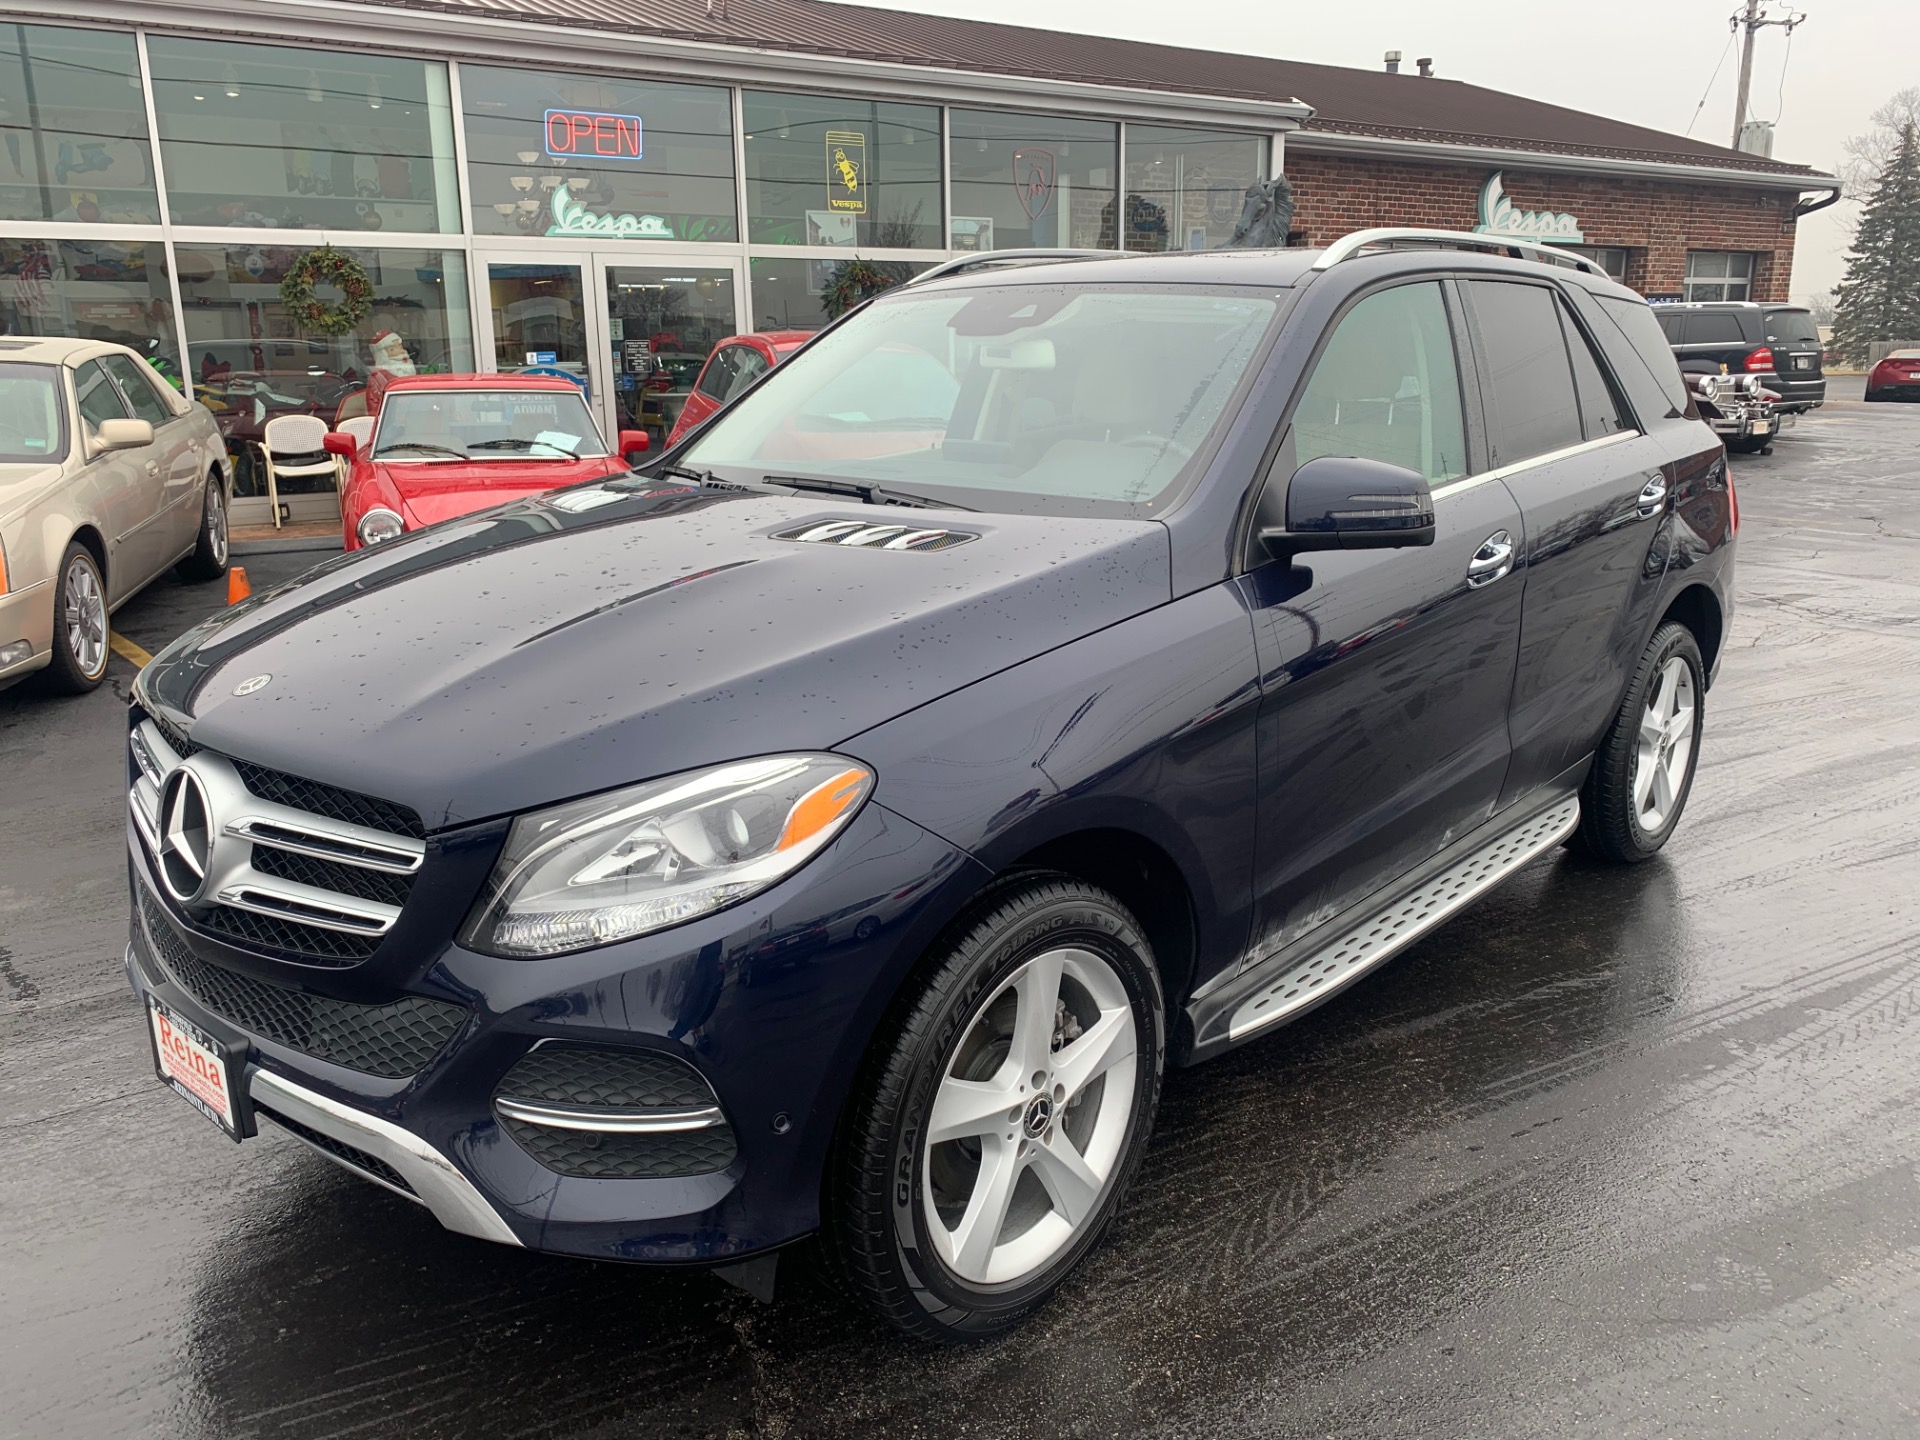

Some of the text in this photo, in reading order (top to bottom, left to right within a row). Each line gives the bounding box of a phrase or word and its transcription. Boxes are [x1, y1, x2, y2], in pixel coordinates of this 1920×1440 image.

[548, 113, 639, 156] OPEN
[545, 183, 675, 239] Vespa
[831, 199, 864, 209] Vespa
[1473, 169, 1584, 243] Vespa
[988, 914, 1063, 973] TOURING
[158, 1013, 223, 1090] Reina
[896, 976, 981, 1209] GRANDTREK
